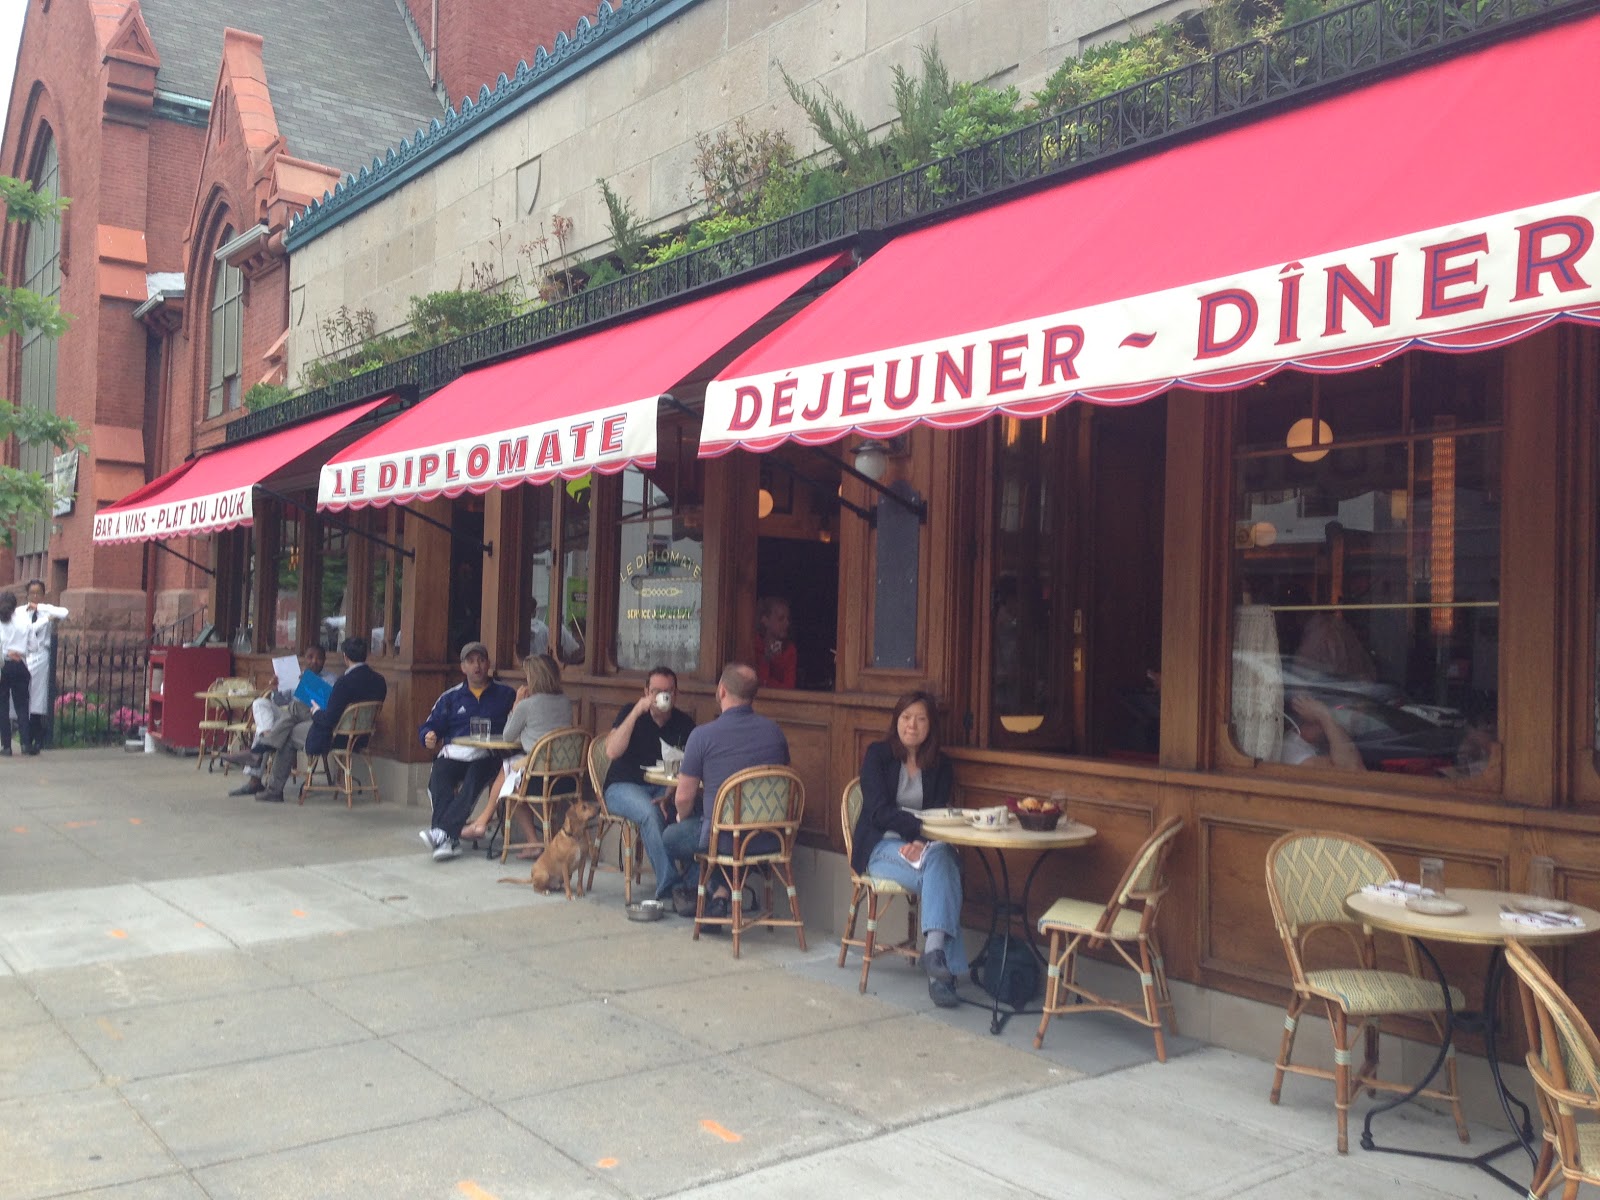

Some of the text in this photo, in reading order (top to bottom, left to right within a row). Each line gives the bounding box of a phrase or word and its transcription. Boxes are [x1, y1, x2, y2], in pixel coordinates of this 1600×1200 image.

[728, 324, 1085, 431] DÉJEUNER
[1193, 214, 1595, 361] DÎNER
[331, 412, 628, 498] LE DIPLOMATE
[94, 517, 112, 537] BAR
[125, 511, 147, 534] VINS
[157, 504, 187, 529] PLAT
[190, 500, 207, 525] DU
[211, 491, 246, 521] JOUR
[620, 562, 634, 582] LE
